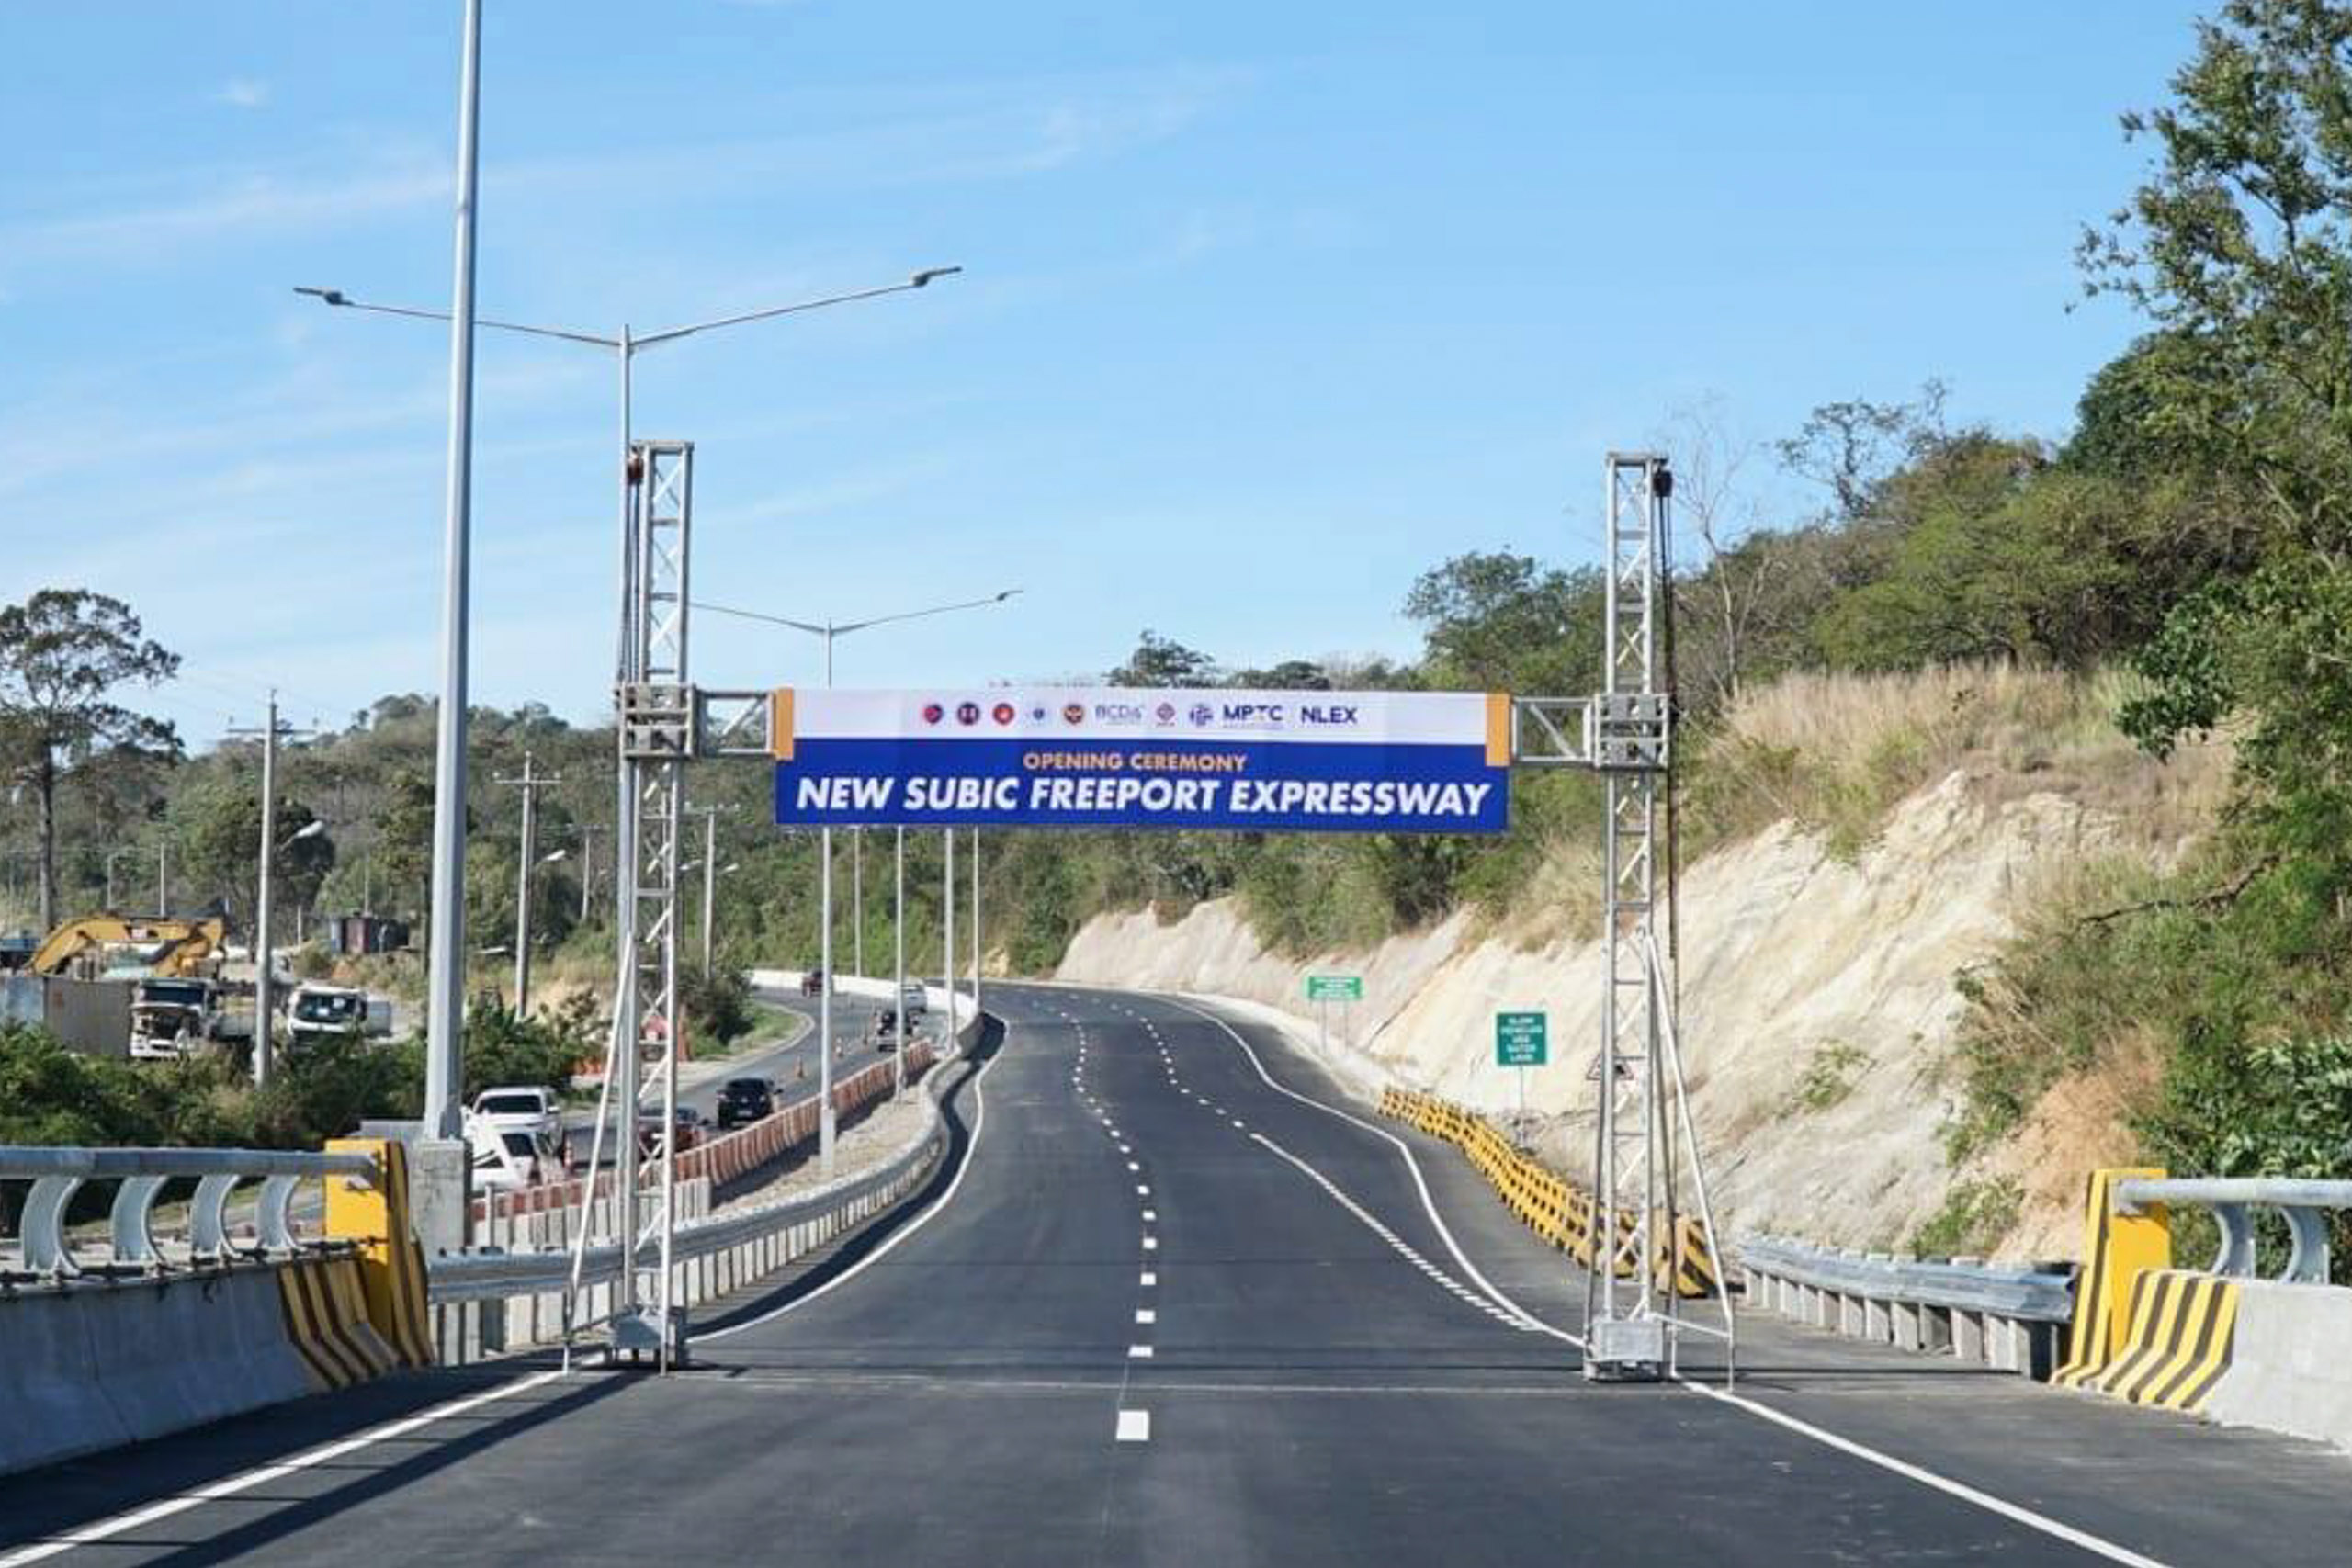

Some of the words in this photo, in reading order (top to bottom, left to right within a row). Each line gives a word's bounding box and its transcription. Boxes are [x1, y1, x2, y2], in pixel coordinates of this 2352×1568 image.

[1301, 706, 1358, 724] NLEX
[1023, 752, 1123, 770] OPENING
[1129, 753, 1248, 772] CEREMONY
[797, 777, 894, 809] NEW
[903, 777, 1021, 809] SUBIC
[1029, 777, 1220, 812] FREEPORT
[1229, 780, 1491, 815] EXPRESSWAY
